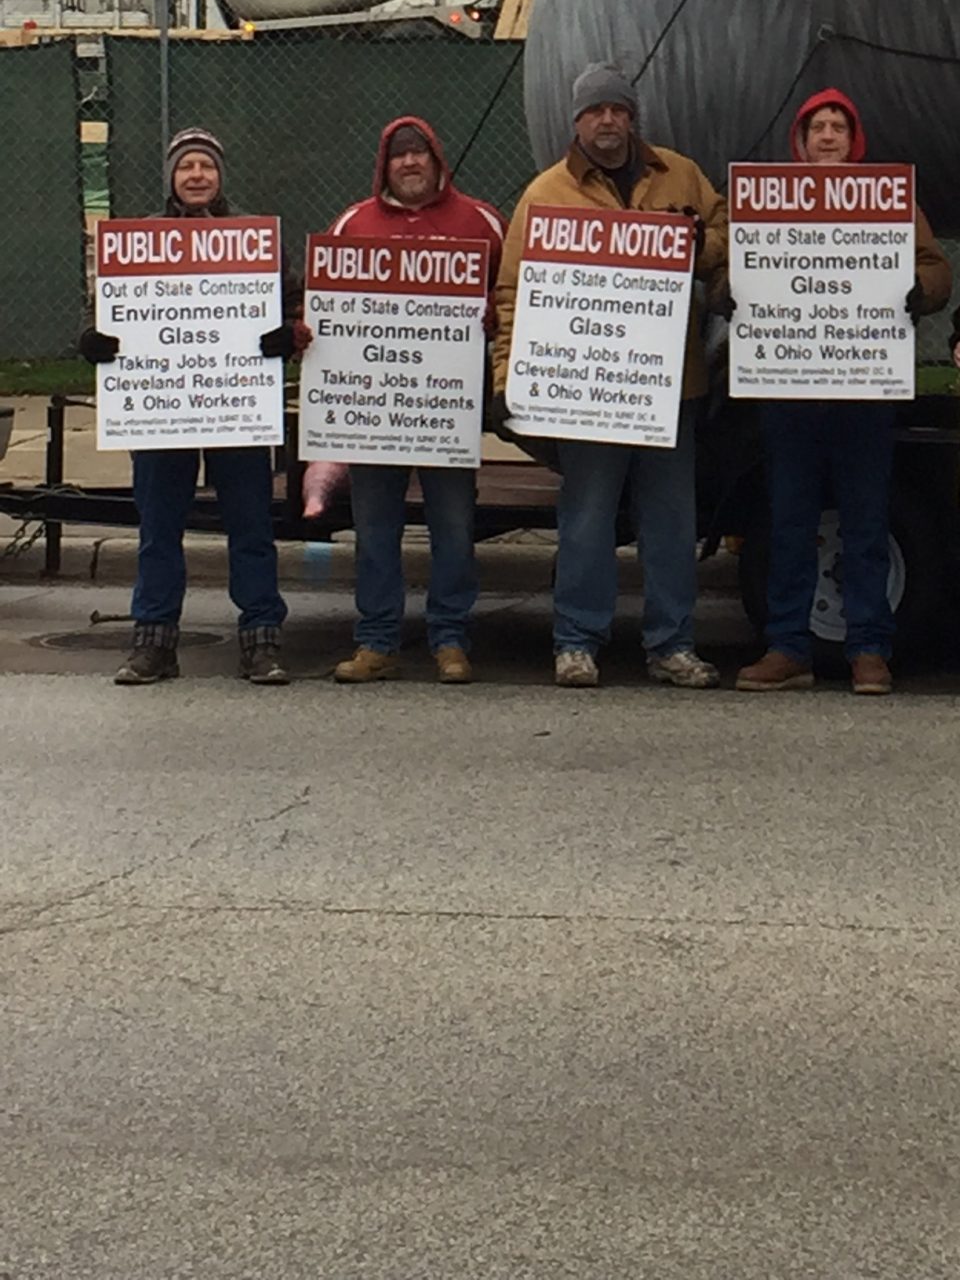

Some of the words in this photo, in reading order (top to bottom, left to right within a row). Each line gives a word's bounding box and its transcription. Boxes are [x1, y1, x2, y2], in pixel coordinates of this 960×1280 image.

[736, 176, 815, 210] PUBLIC
[825, 176, 906, 210] NOTICE
[103, 229, 182, 264] PUBLIC
[191, 228, 272, 261] NOTICE
[528, 216, 603, 253] PUBLIC
[609, 222, 688, 258] NOTICE
[734, 226, 760, 245] Out
[766, 228, 781, 245] of
[787, 227, 825, 245] State
[831, 227, 908, 245] Contractor
[313, 246, 391, 281] PUBLIC
[399, 250, 481, 284] NOTICE
[743, 251, 898, 270] Environmental
[101, 281, 127, 298] Out
[133, 281, 148, 298] of
[154, 279, 192, 297] State
[198, 278, 274, 295] Contractor
[523, 265, 547, 283] Out
[551, 269, 566, 284] of
[571, 269, 607, 288] State
[612, 272, 684, 293] Contractor
[790, 275, 852, 294] Glass
[111, 301, 266, 322] Environmental
[309, 294, 334, 312] Out
[340, 297, 355, 313] of
[361, 297, 399, 315] State
[404, 299, 480, 318] Contractor
[528, 289, 673, 317] Environmental
[748, 303, 801, 322] Taking
[808, 303, 849, 319] Jobs
[856, 303, 895, 319] from
[158, 326, 220, 345] Glass
[317, 318, 470, 342] Environmental
[569, 316, 625, 338] Glass
[735, 322, 816, 339] Cleveland
[823, 324, 906, 340] Residents
[362, 344, 423, 364] Glass
[528, 340, 576, 363] Taking
[582, 345, 620, 363] Jobs
[627, 349, 663, 365] from
[754, 344, 766, 359] &
[774, 343, 812, 360] Ohio
[819, 345, 887, 360] Workers
[118, 353, 169, 373] Taking
[176, 353, 217, 369] Jobs
[224, 353, 264, 367] from
[513, 359, 589, 380] Cleveland
[594, 366, 672, 387] Residents
[103, 374, 185, 392] Cleveland
[192, 372, 275, 388] Residents
[320, 369, 372, 390] Taking
[379, 372, 418, 388] Jobs
[425, 374, 463, 390] from
[122, 395, 134, 411] &
[142, 394, 181, 410] Ohio
[188, 393, 256, 408] Workers
[307, 388, 386, 407] Cleveland
[393, 392, 475, 410] Residents
[528, 381, 539, 397] &
[547, 382, 582, 400] Ohio
[589, 386, 652, 406] Workers
[324, 409, 335, 424] &
[343, 410, 381, 427] Ohio
[388, 412, 455, 430] Workers
